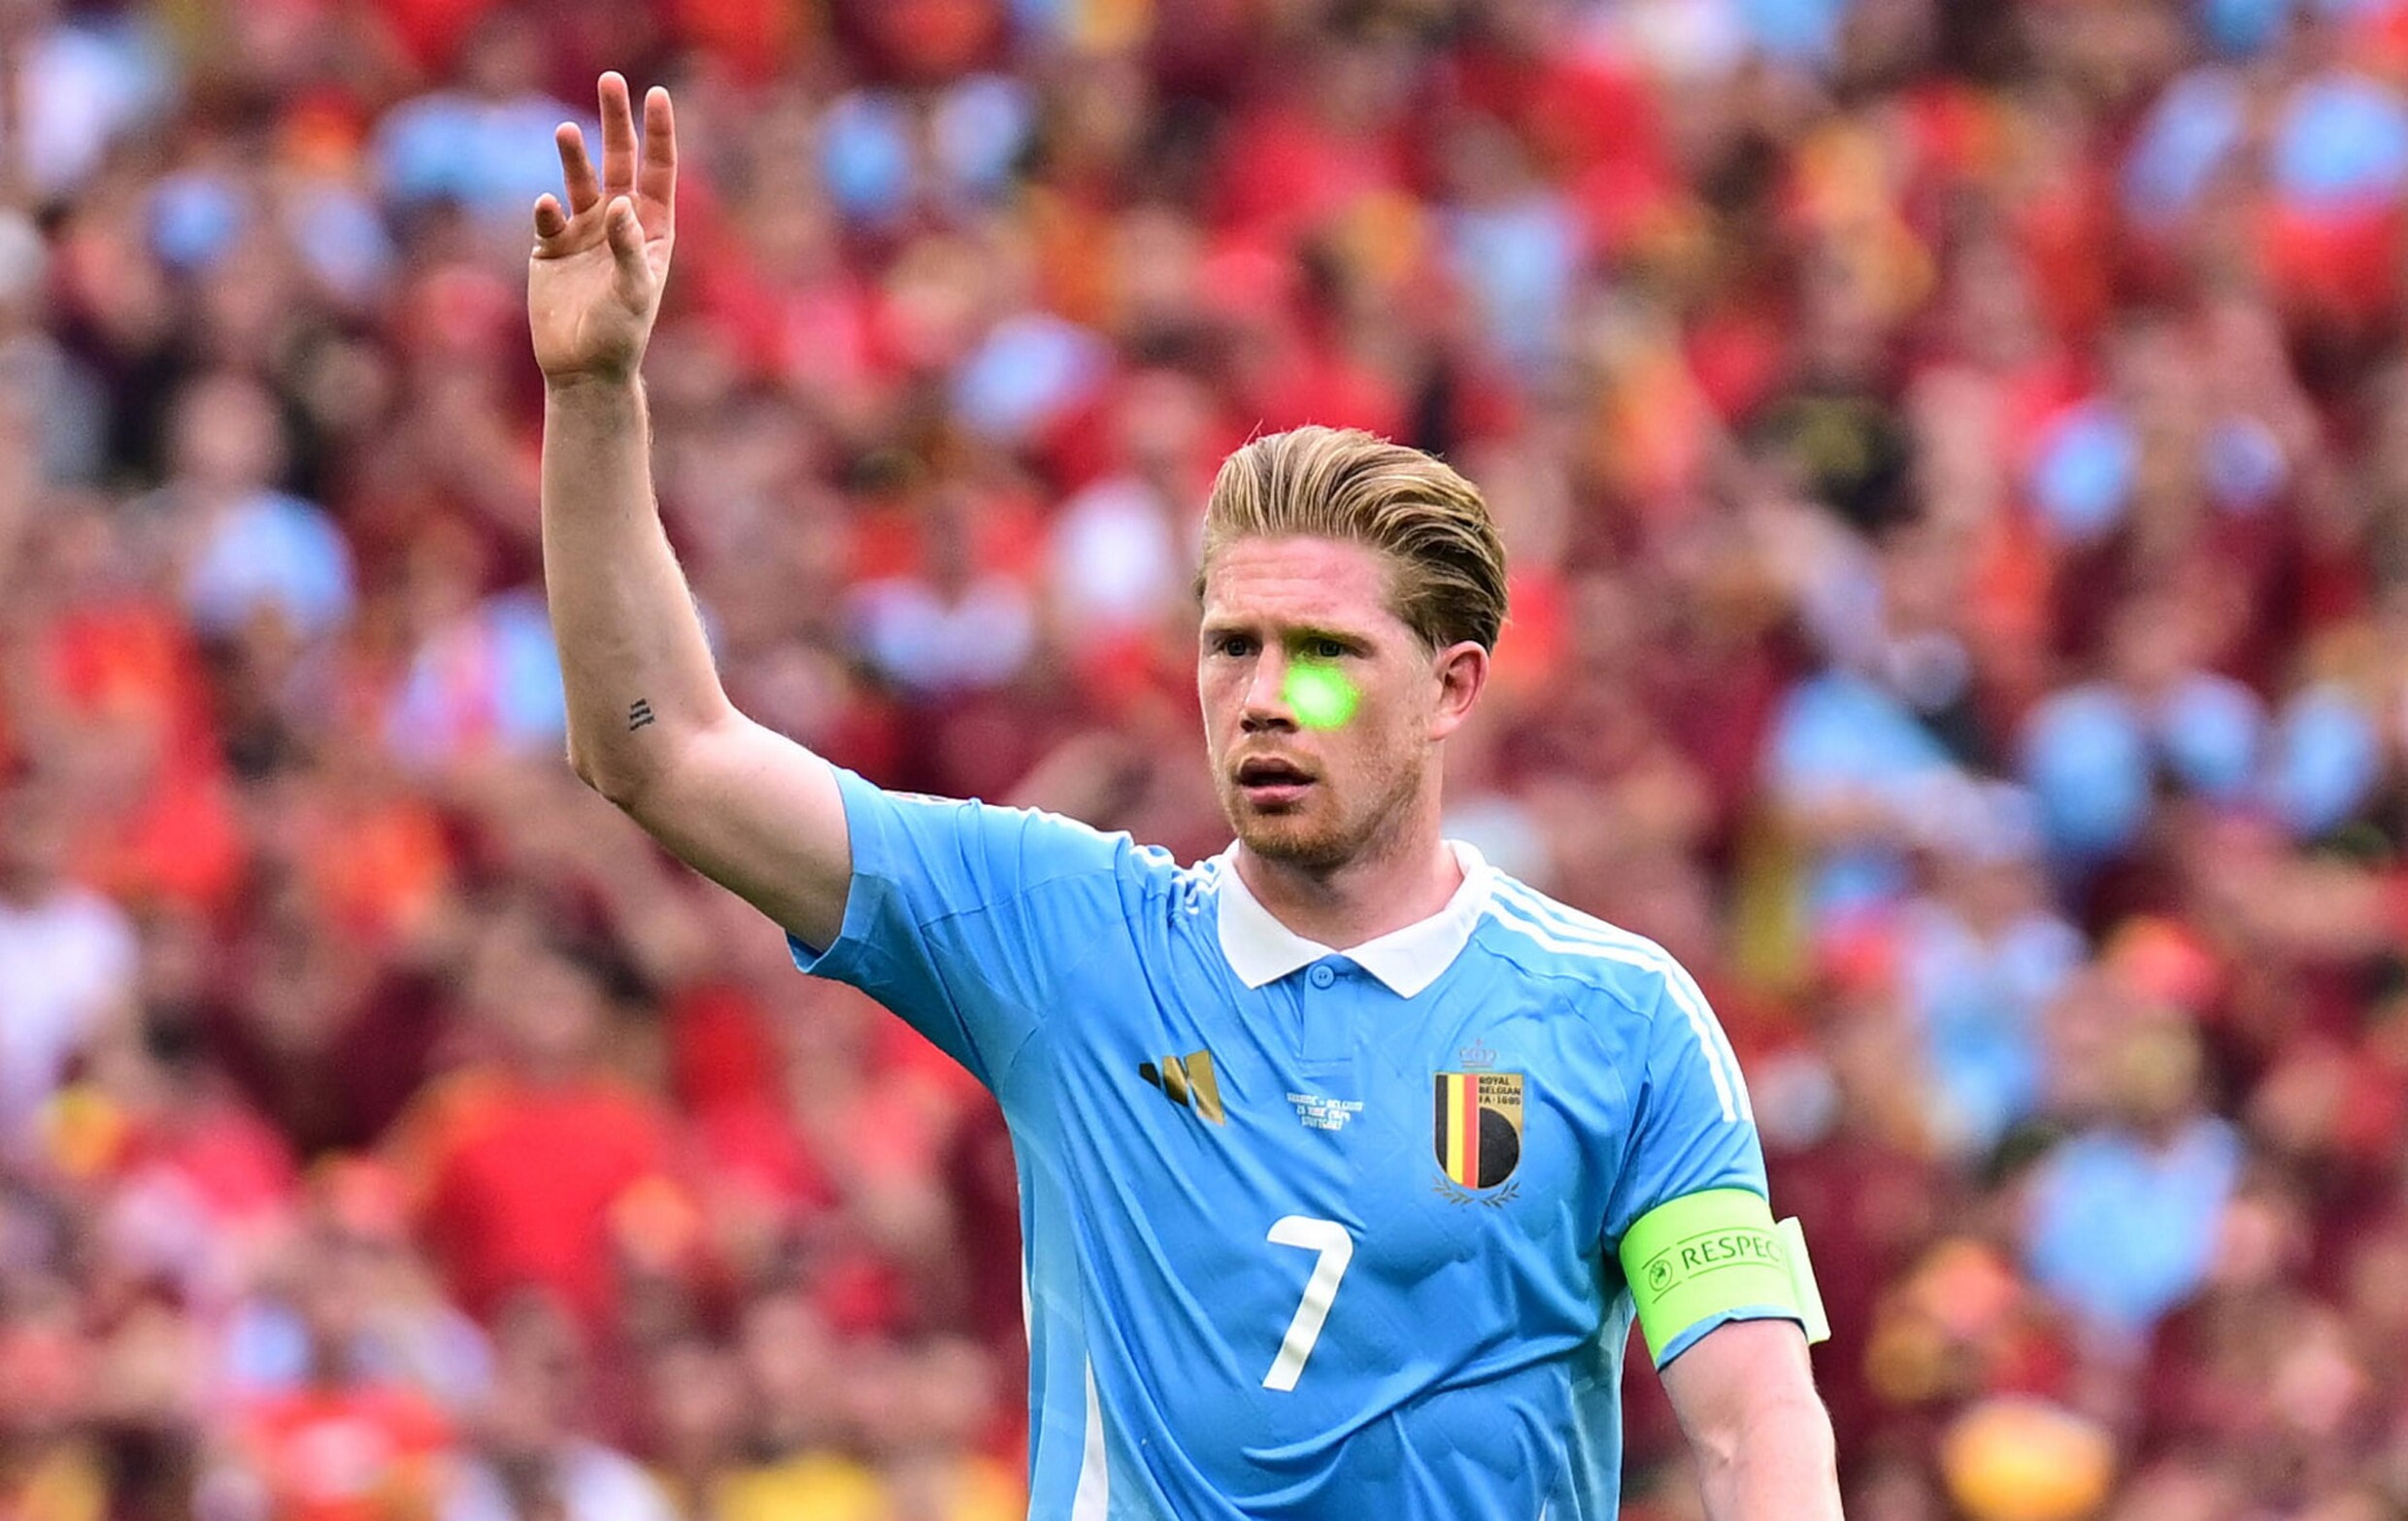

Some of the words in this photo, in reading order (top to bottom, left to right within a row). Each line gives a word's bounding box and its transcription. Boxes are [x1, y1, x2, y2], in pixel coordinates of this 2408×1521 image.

[1479, 1076, 1510, 1085] ROYAL
[1681, 1234, 1784, 1270] RESPEC
[1262, 1215, 1354, 1393] 7
